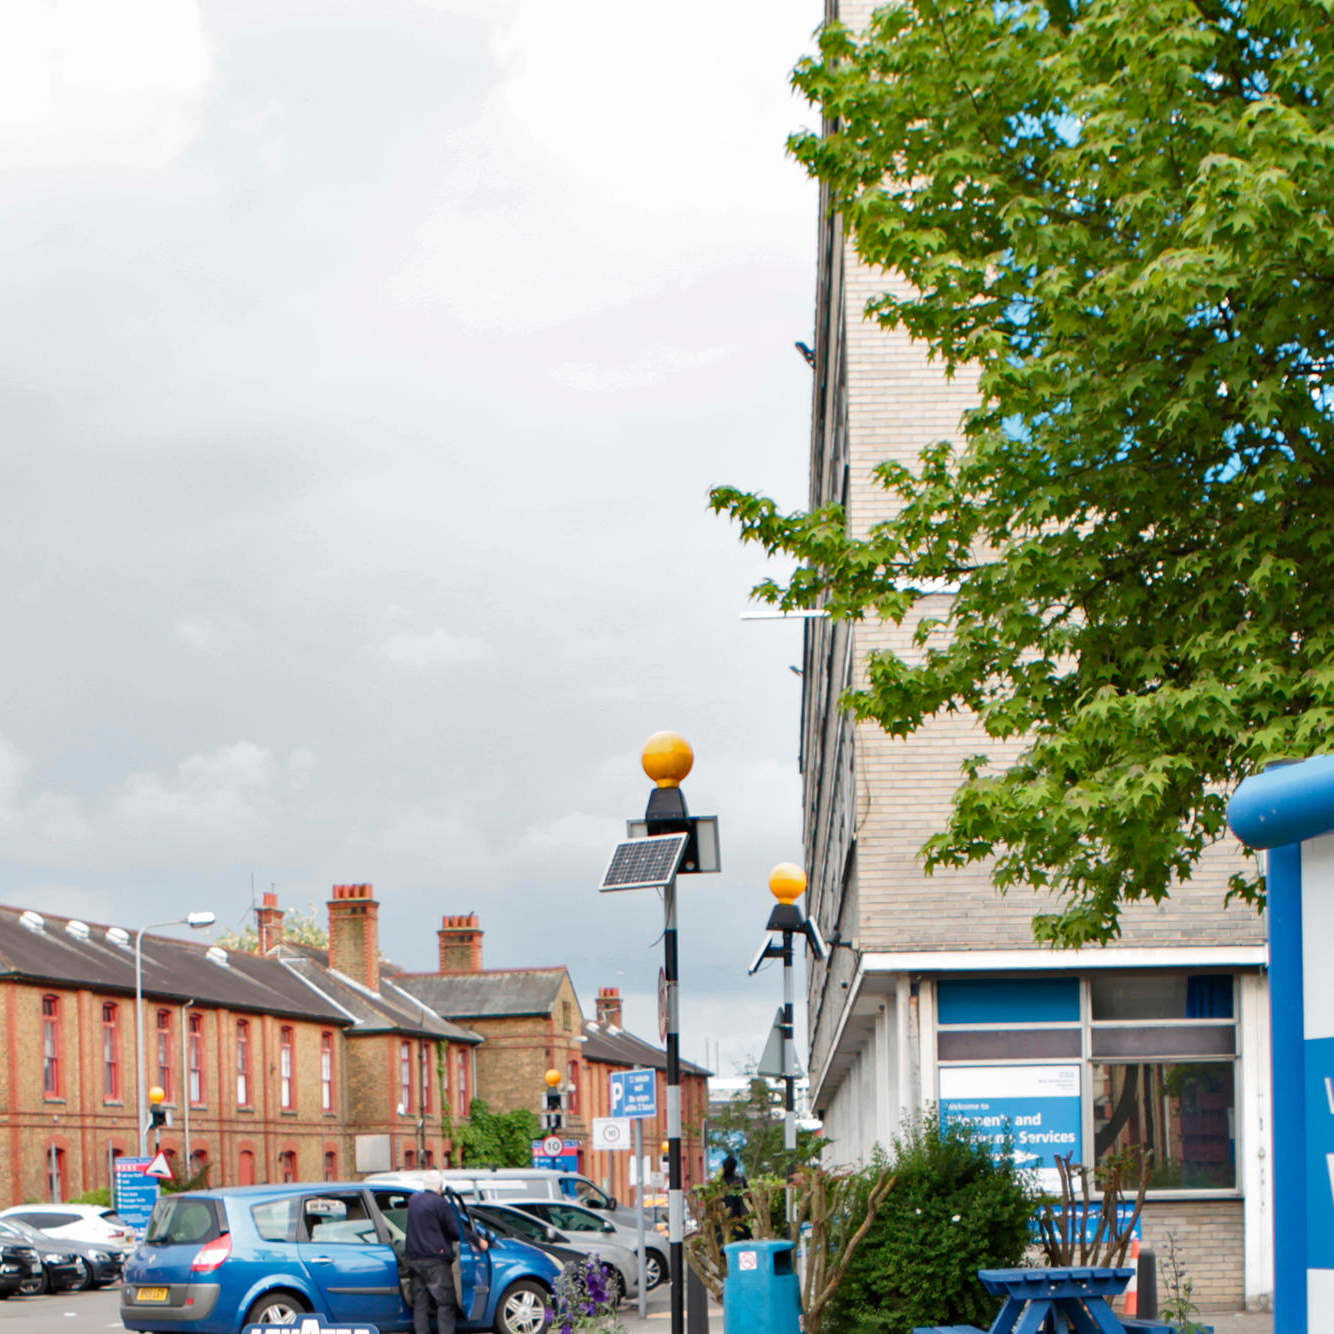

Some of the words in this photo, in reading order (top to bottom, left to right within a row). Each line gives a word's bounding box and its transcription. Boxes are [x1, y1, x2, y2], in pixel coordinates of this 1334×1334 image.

[611, 1082, 623, 1110] P
[980, 1102, 990, 1111] to
[1014, 1112, 1042, 1126] and
[1019, 1129, 1076, 1145] Services
[547, 1141, 560, 1151] 10
